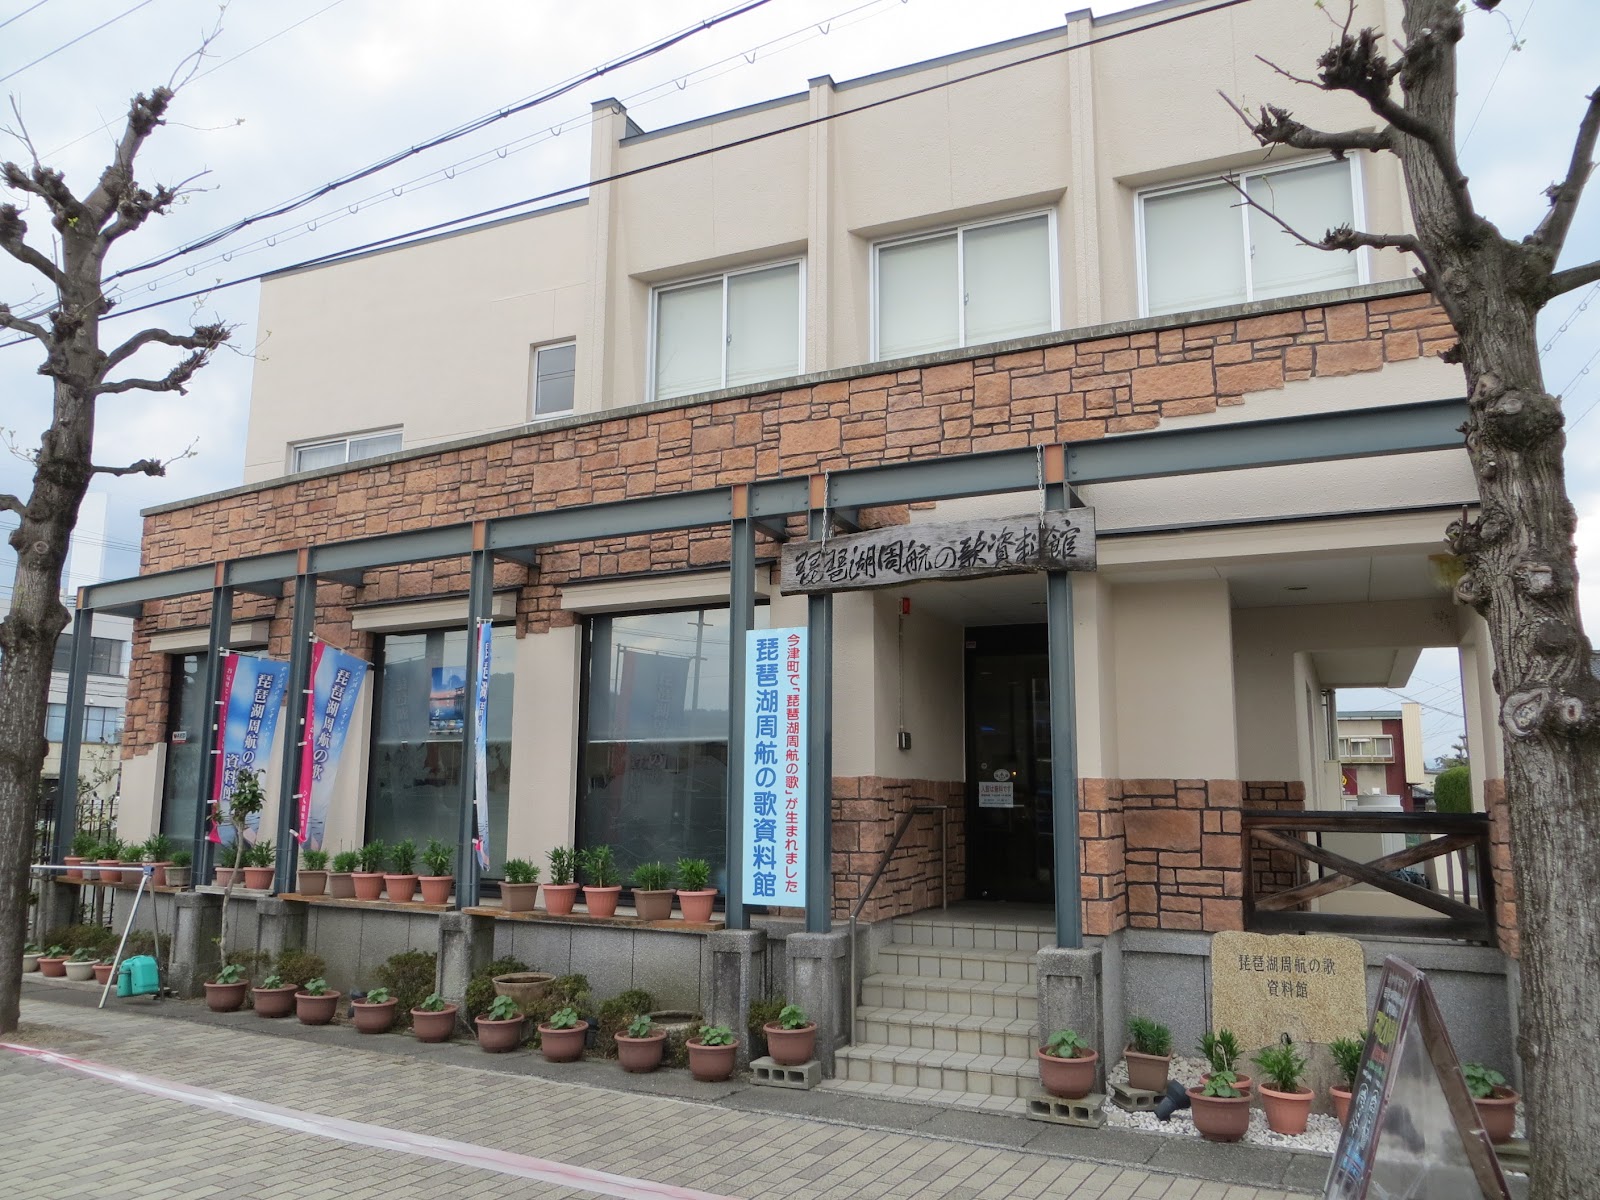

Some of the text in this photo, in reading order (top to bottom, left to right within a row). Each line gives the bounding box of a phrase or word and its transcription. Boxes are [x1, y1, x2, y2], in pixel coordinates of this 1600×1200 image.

[795, 519, 1080, 585] 琵琶湖周航の歌資料館
[752, 638, 779, 897] 琵琶湖周航の歌資料館
[785, 633, 800, 893] 今津町で「琵琶湖周航の歌」が生まれました
[1238, 954, 1336, 976] 琵琶湖周航の歌
[1267, 979, 1308, 998] 資料館
